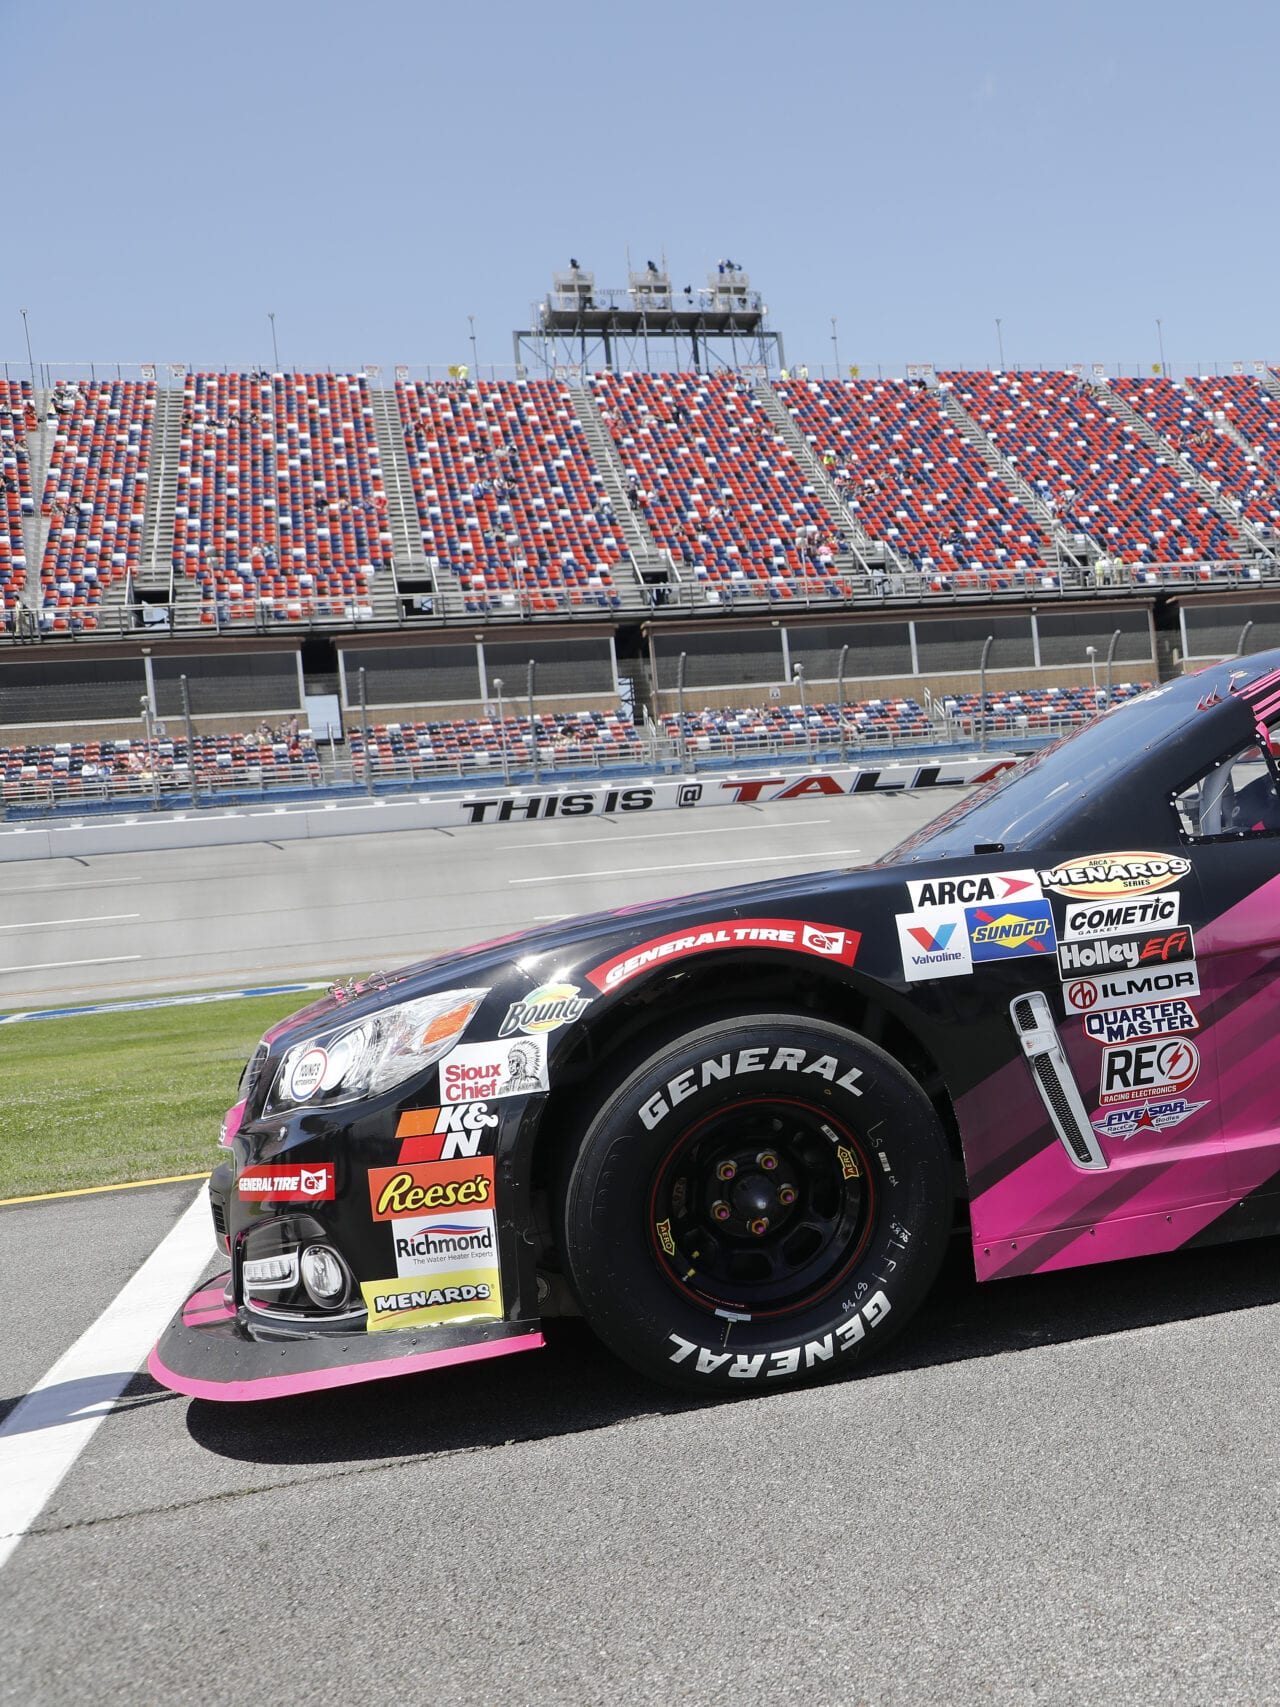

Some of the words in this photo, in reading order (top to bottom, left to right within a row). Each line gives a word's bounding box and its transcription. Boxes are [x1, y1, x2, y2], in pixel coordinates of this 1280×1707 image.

[461, 794, 594, 824] THIS
[603, 786, 656, 813] IS
[676, 782, 703, 807] @
[1040, 859, 1189, 888] MENARDS
[1122, 879, 1151, 888] SERIES
[918, 878, 996, 907] ARCA
[1070, 899, 1175, 931] COMETIC
[972, 919, 1049, 944] SUNOCO
[1078, 926, 1119, 936] GASKET
[605, 931, 732, 985] GENERAL
[734, 928, 796, 943] TIRE
[911, 951, 963, 966] Valvoline
[1060, 940, 1140, 970] Holley
[1102, 971, 1195, 998] ILMOR
[498, 998, 593, 1037] Bounty
[1086, 1001, 1187, 1035] QUARTER
[1106, 1014, 1195, 1043] MASTER
[445, 1063, 502, 1082] Sioux
[445, 1079, 497, 1101] Chief
[638, 1047, 864, 1131] GENERAL
[1104, 1092, 1130, 1104] RACING
[1131, 1085, 1177, 1099] ELECTRONICS
[1107, 1109, 1144, 1126] FIVE
[1148, 1101, 1186, 1116] STAR
[840, 1151, 856, 1175] AERO
[239, 1177, 272, 1191] GENERAL
[273, 1176, 299, 1191] TIRE
[378, 1174, 490, 1214] Reese's
[397, 1227, 492, 1258] Richmond
[660, 1225, 673, 1250] AERO
[413, 1257, 426, 1265] The
[426, 1255, 447, 1264] Water
[448, 1253, 469, 1262] Heater
[471, 1251, 494, 1261] Experts
[376, 1284, 490, 1311] MENARDS
[667, 1290, 893, 1379] GENERAL
